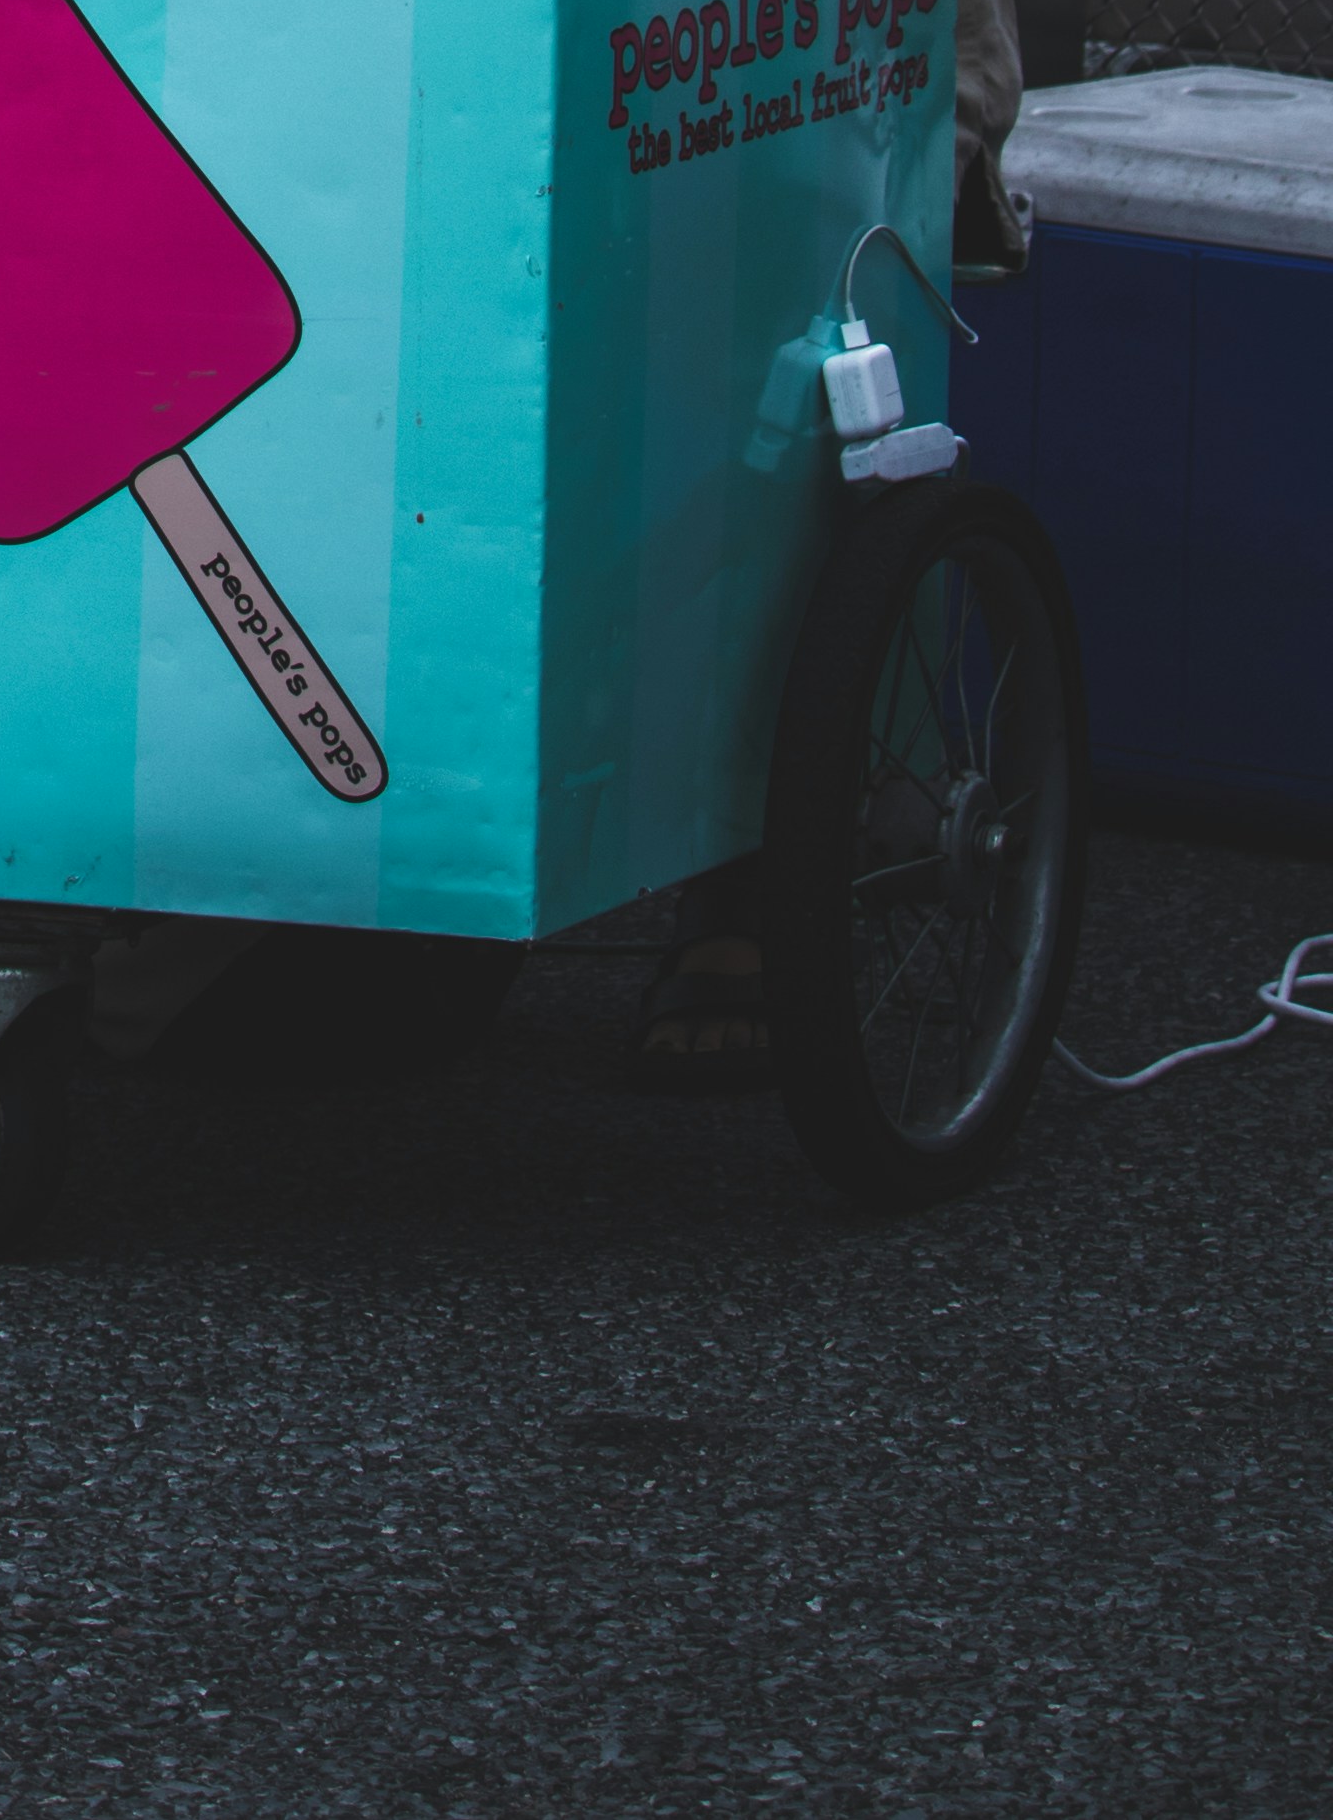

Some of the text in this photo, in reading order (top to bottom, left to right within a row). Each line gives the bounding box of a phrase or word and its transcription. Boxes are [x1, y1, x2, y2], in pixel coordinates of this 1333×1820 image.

[628, 52, 930, 174] the best local fruit pops
[200, 552, 367, 785] people's pops
